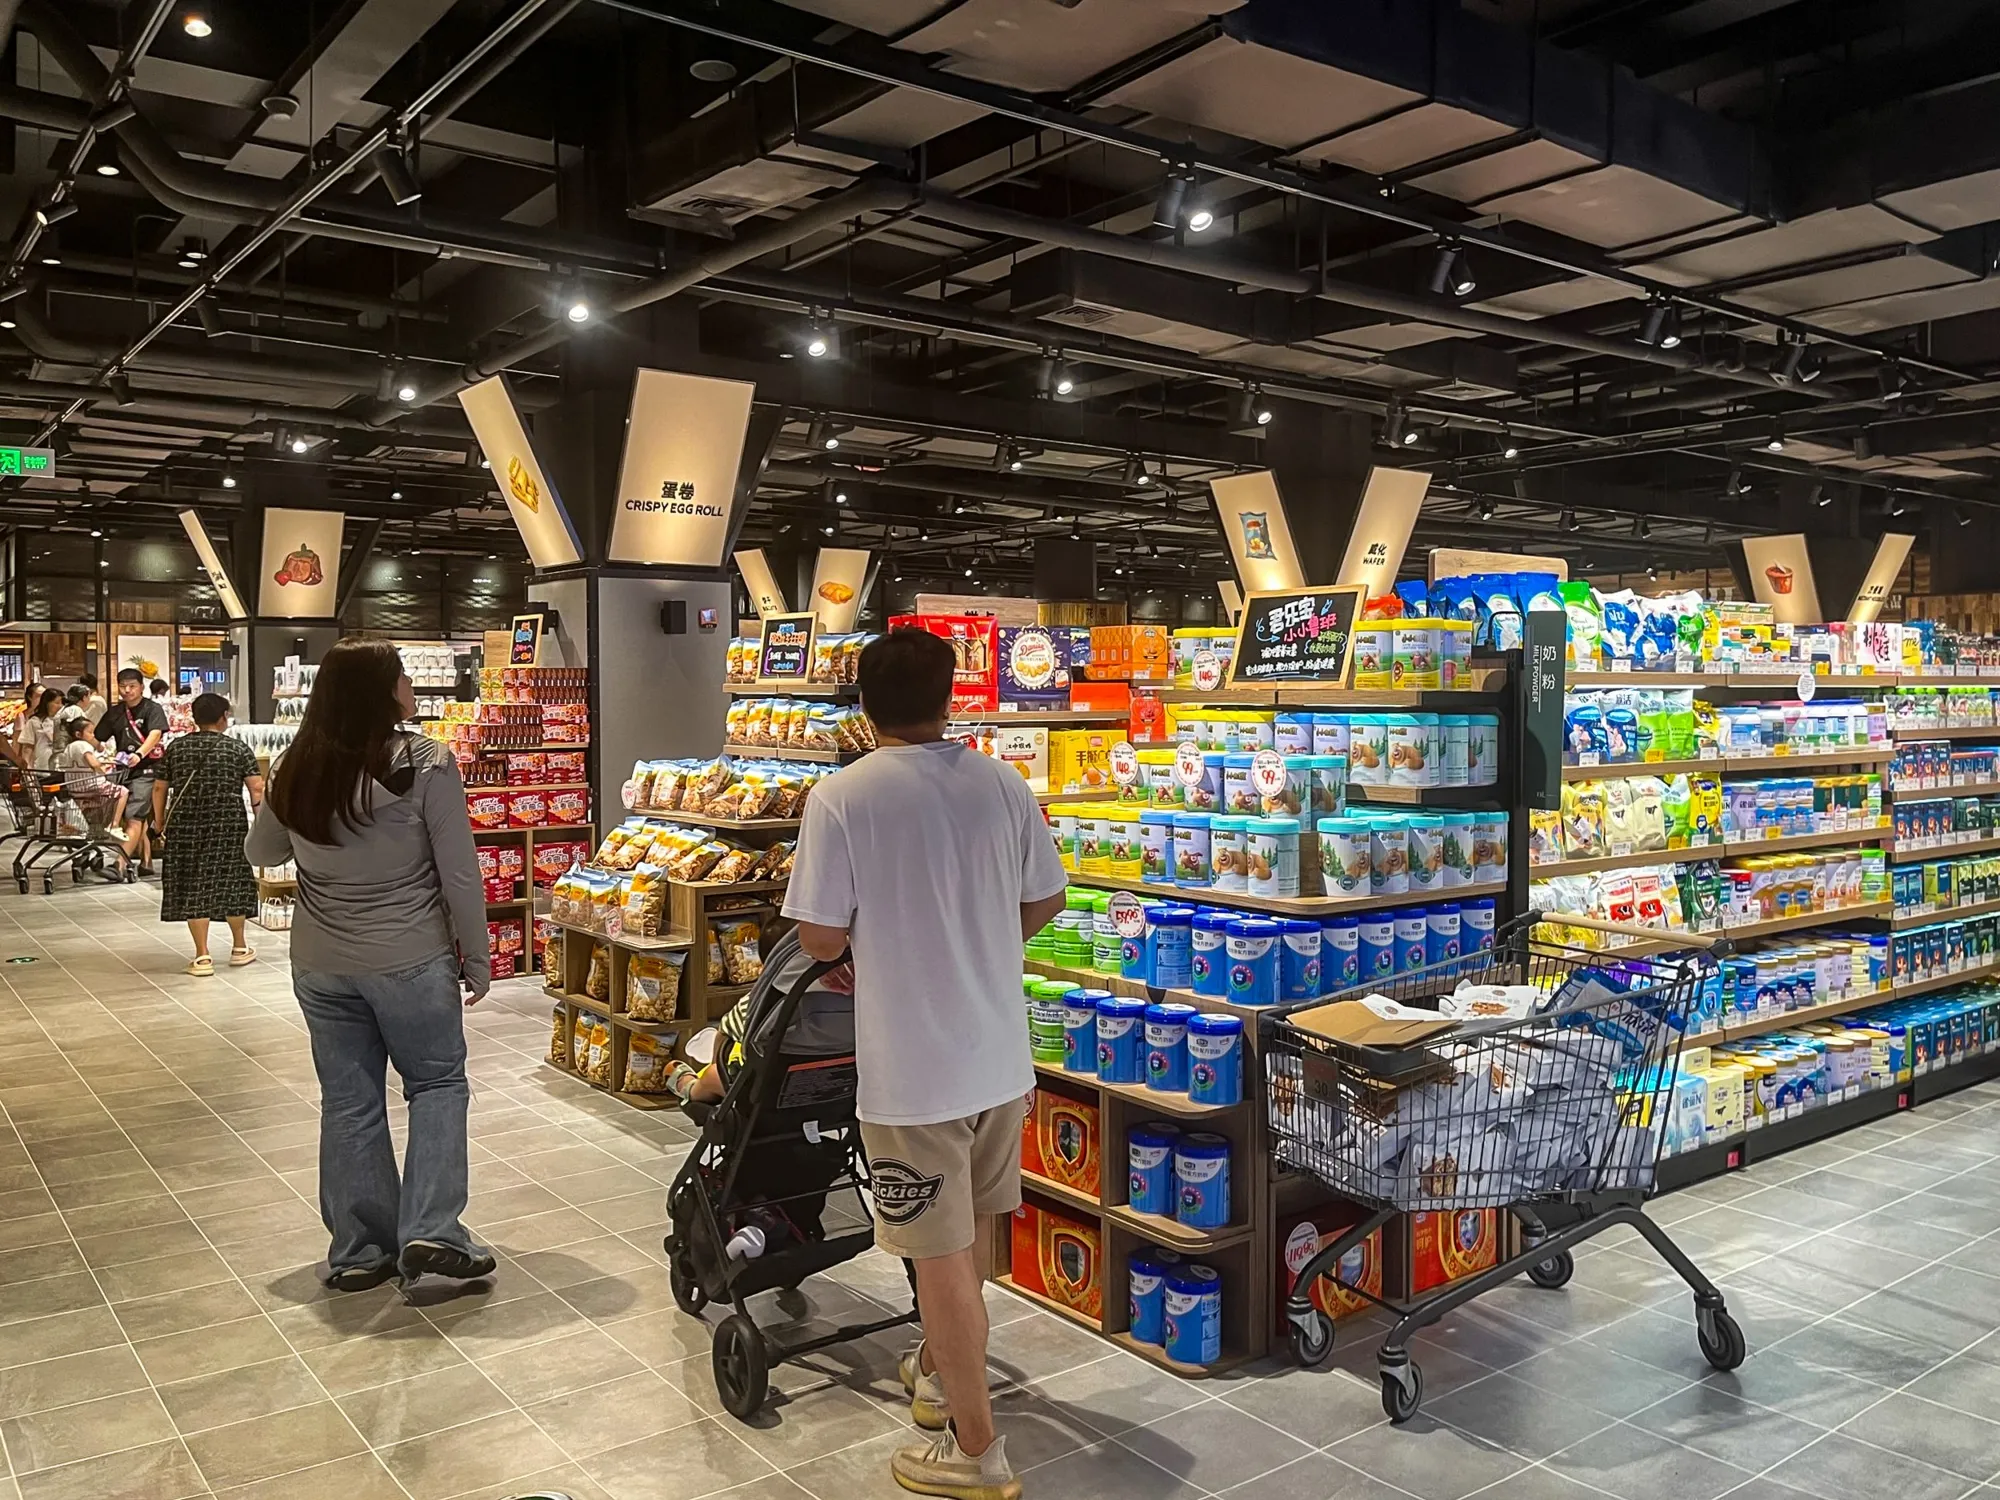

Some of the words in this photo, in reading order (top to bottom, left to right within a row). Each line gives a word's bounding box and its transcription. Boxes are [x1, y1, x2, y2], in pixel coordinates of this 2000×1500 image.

[661, 480, 695, 501] 蛋卷
[625, 499, 669, 513] CRISPY
[670, 503, 694, 514] EGG
[695, 504, 724, 517] ROLL
[1363, 557, 1386, 566] WAFER
[1541, 645, 1556, 690] 奶粉
[1531, 665, 1539, 703] POWDER
[1261, 769, 1276, 785] 99
[872, 1180, 933, 1199] Dickies
